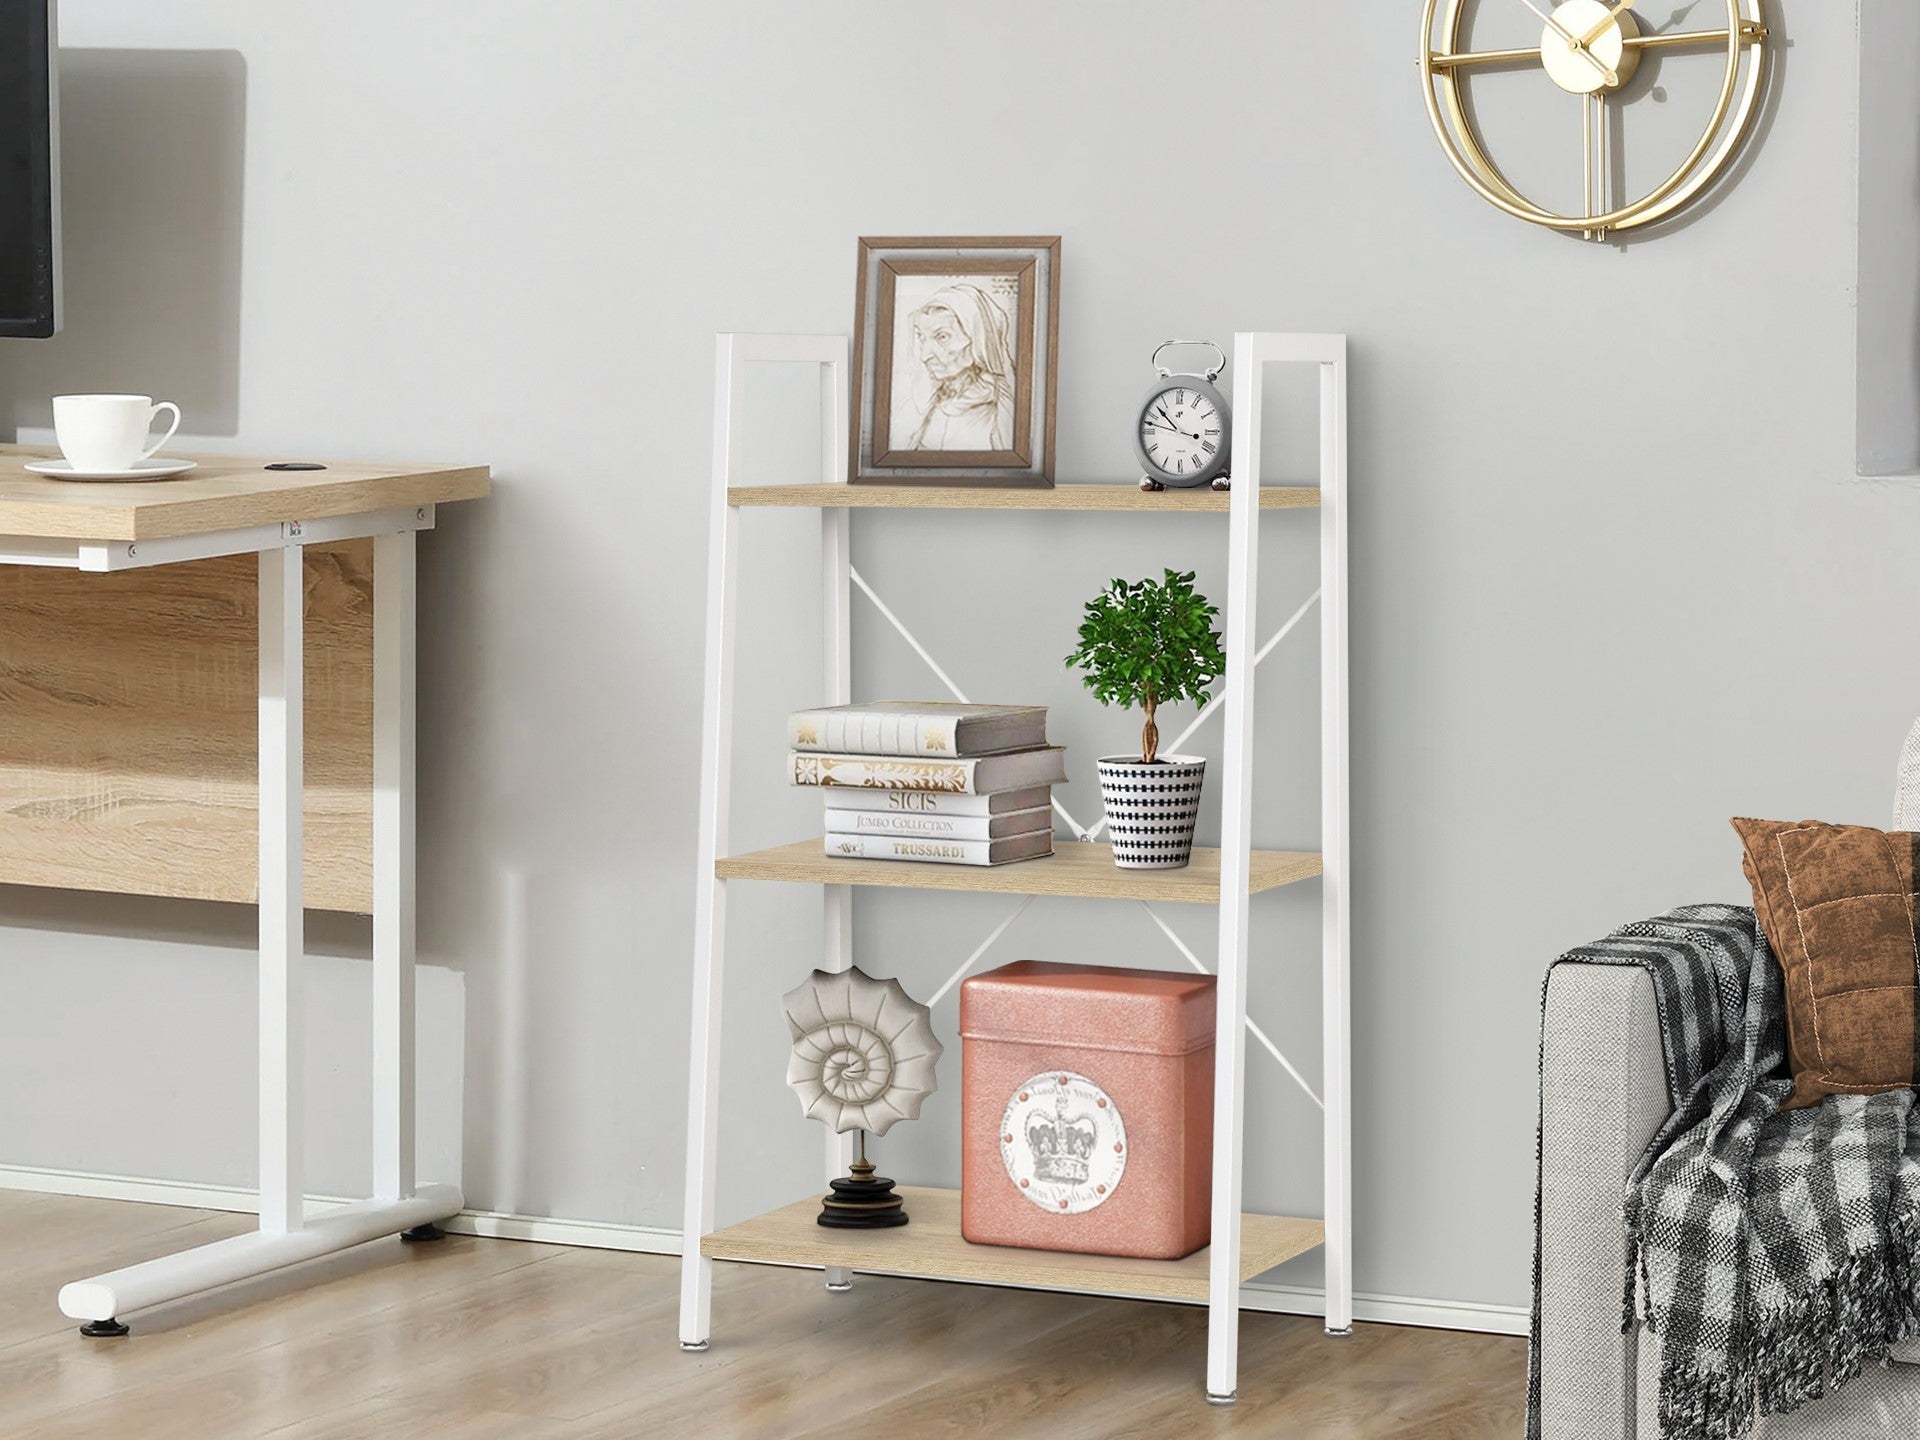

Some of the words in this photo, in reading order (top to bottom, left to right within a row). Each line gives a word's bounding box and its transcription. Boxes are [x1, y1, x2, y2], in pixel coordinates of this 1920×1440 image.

[888, 792, 937, 811] SICIS
[857, 815, 890, 829] JUMBO
[892, 817, 954, 831] COLLECTION
[893, 843, 965, 858] TRUSSARDI
